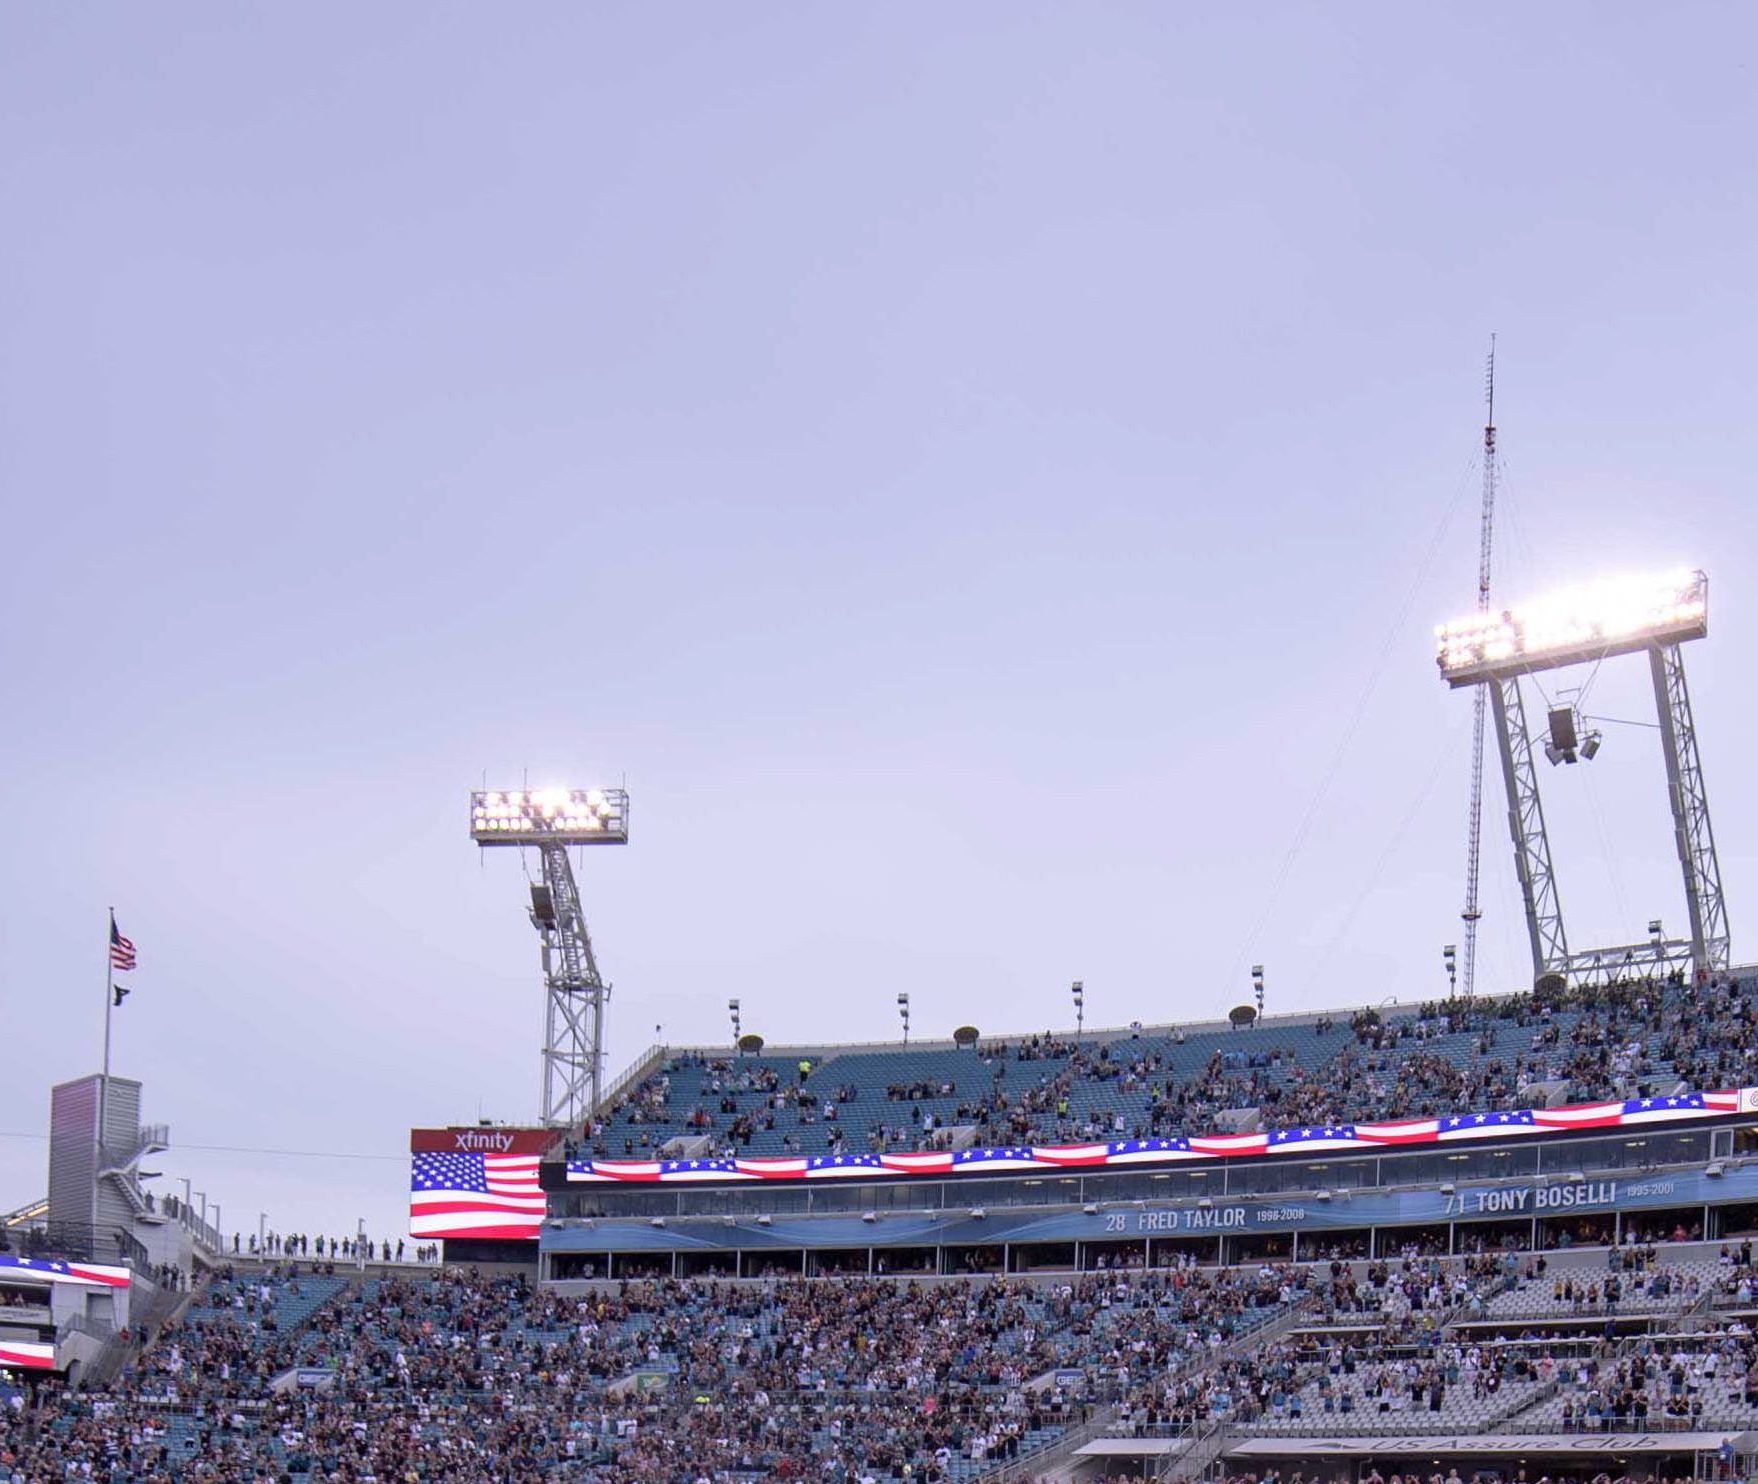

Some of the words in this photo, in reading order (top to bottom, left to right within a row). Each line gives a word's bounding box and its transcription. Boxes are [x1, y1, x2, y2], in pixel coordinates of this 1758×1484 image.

[454, 1130, 514, 1152] xfinity
[1445, 1194, 1465, 1214] 71
[1477, 1189, 1527, 1212] TONY
[1535, 1182, 1616, 1208] BOSELLI
[1106, 1214, 1126, 1232] 28
[1139, 1210, 1178, 1231] FRED
[1184, 1208, 1245, 1229] TAYLOR
[1370, 1440, 1425, 1451] US
[1430, 1439, 1561, 1451] Assure
[1570, 1435, 1659, 1450] Club
